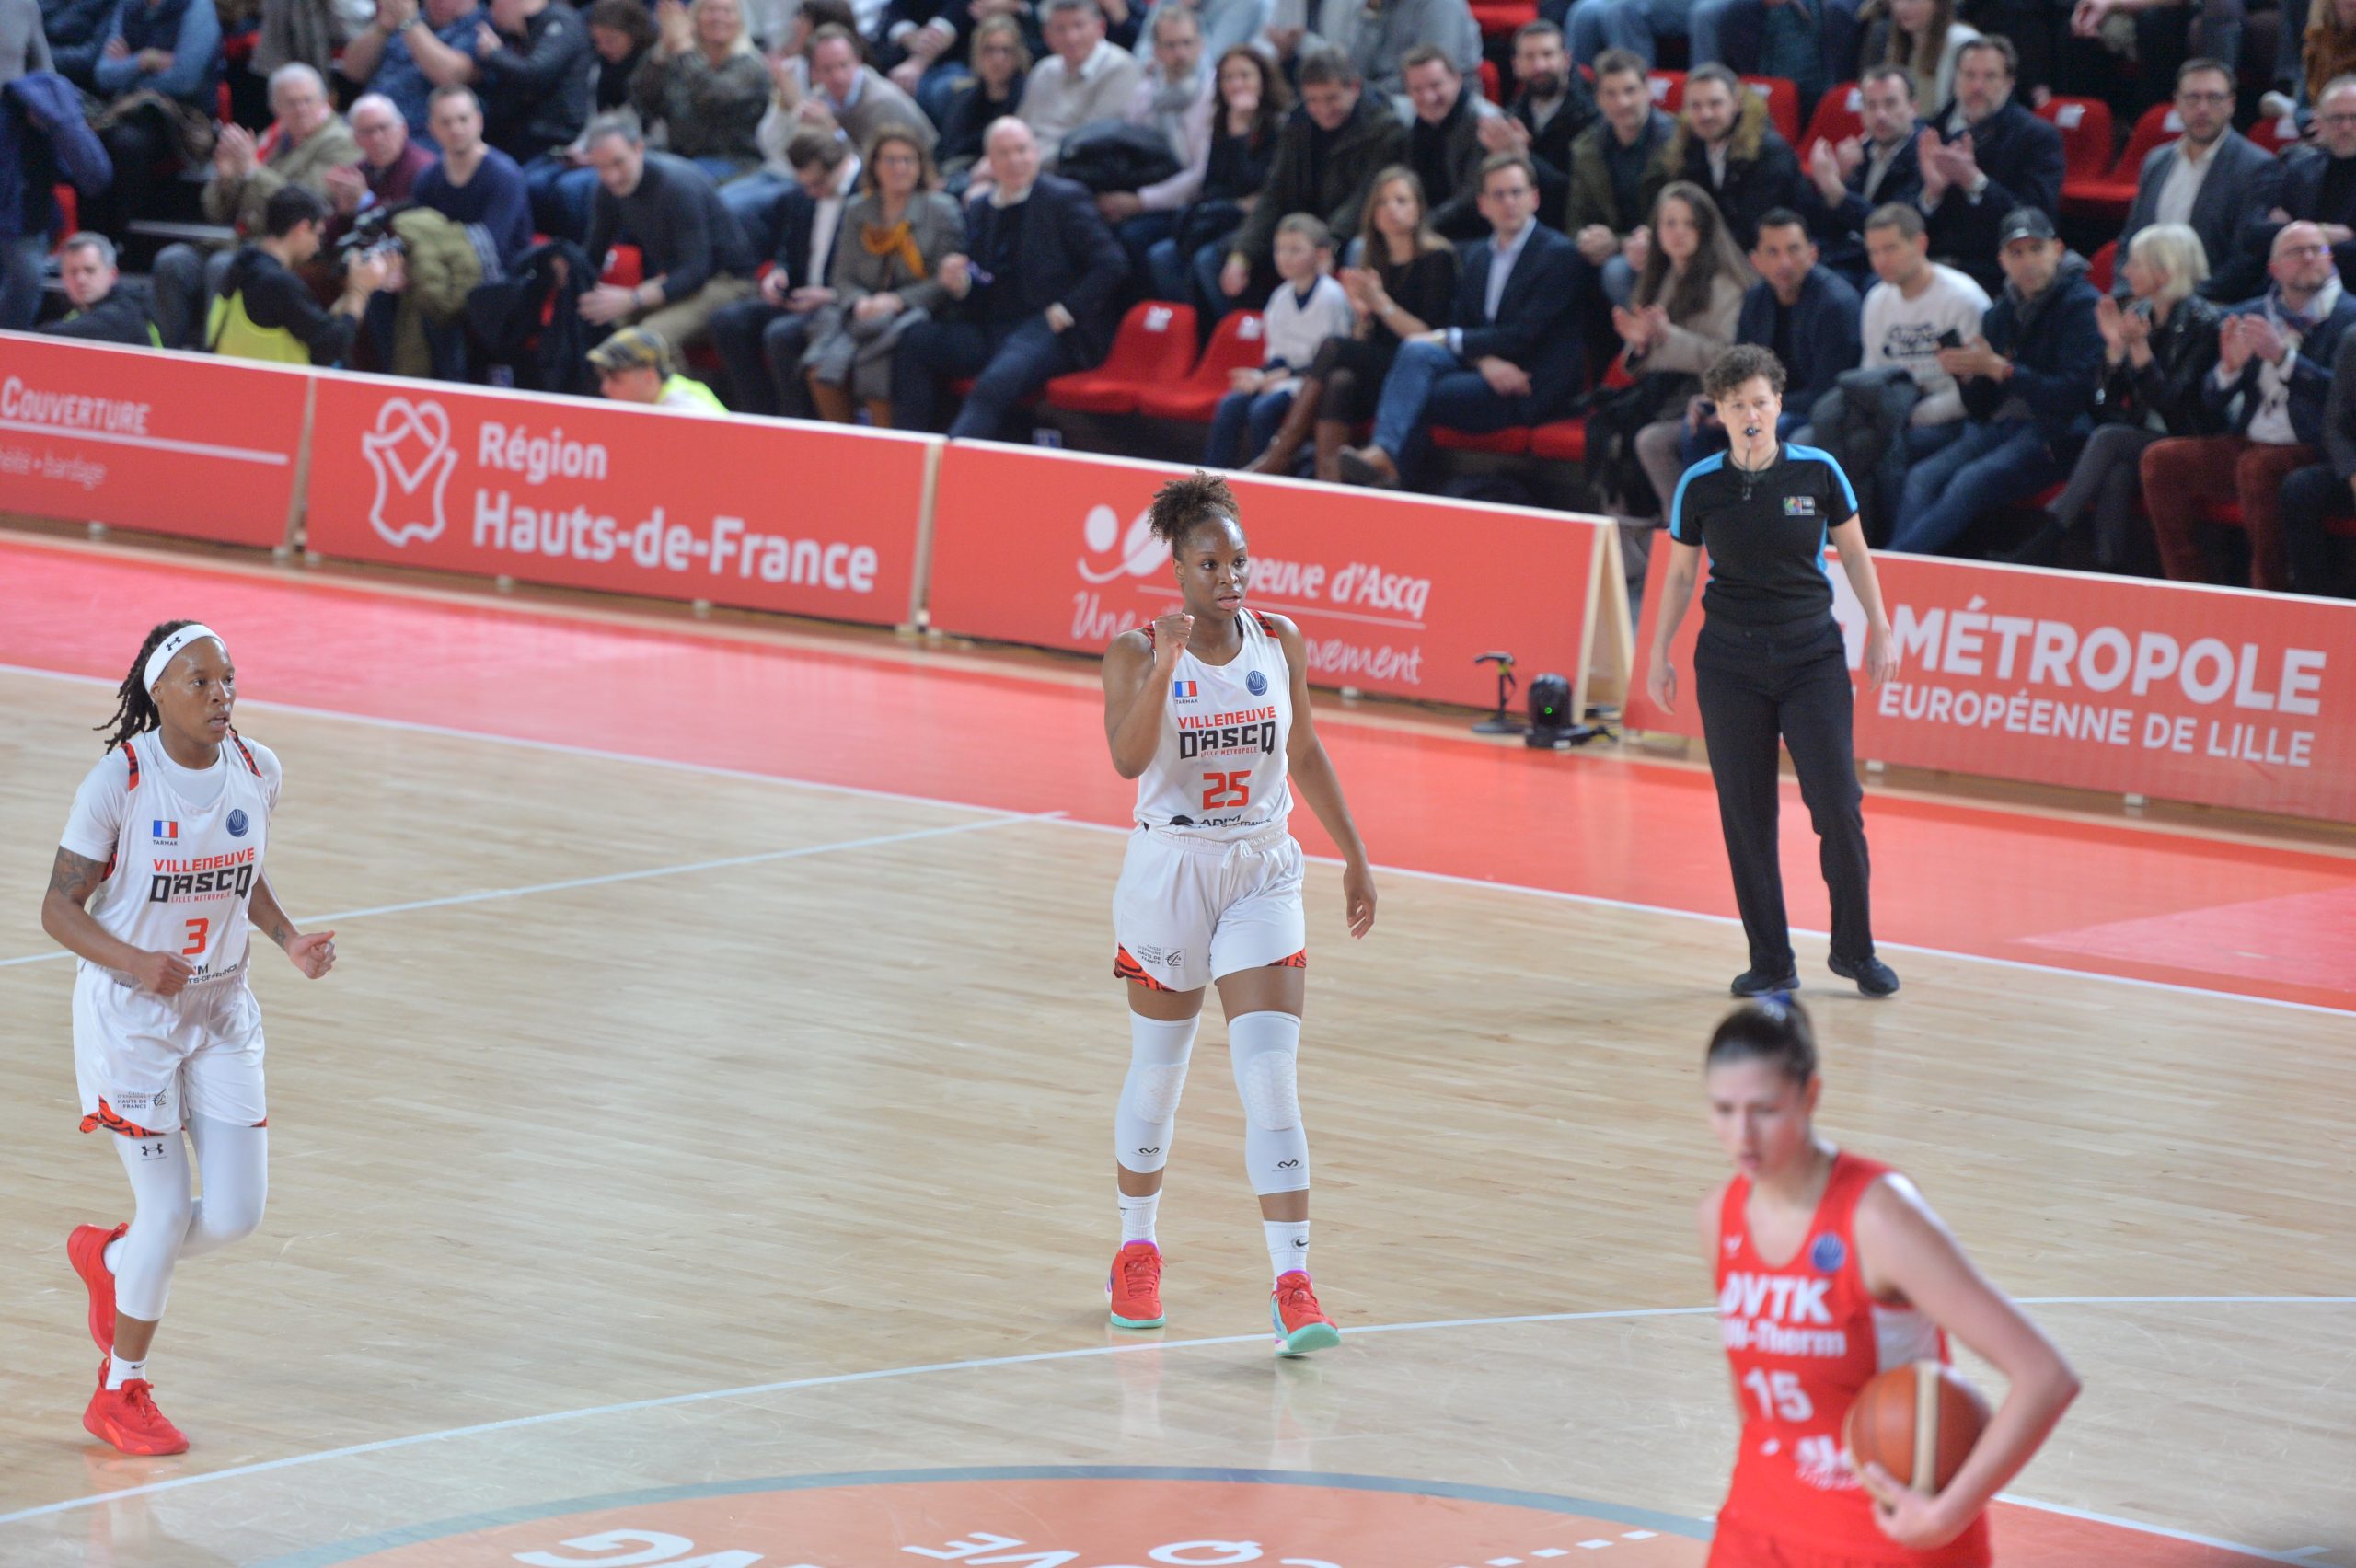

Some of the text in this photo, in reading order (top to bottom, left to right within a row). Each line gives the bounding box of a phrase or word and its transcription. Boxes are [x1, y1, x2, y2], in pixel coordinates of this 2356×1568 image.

[479, 421, 607, 484] Région
[472, 489, 879, 593] Hauts-de-France
[1330, 560, 1431, 619] d'Ascq
[1890, 594, 2327, 716] MÉTROPOLE
[1178, 706, 1276, 730] VILLENEUVE
[1178, 721, 1276, 760] D'ASCQ
[1877, 683, 2316, 768] EUROPÉENNE DE LILLE
[1203, 770, 1252, 811] 25
[149, 863, 253, 903] D'ASCQ
[153, 847, 255, 873] VILLENEUVE
[182, 917, 210, 956] 3
[1721, 1271, 1833, 1325] DVTK
[1744, 1366, 1814, 1423] 15
